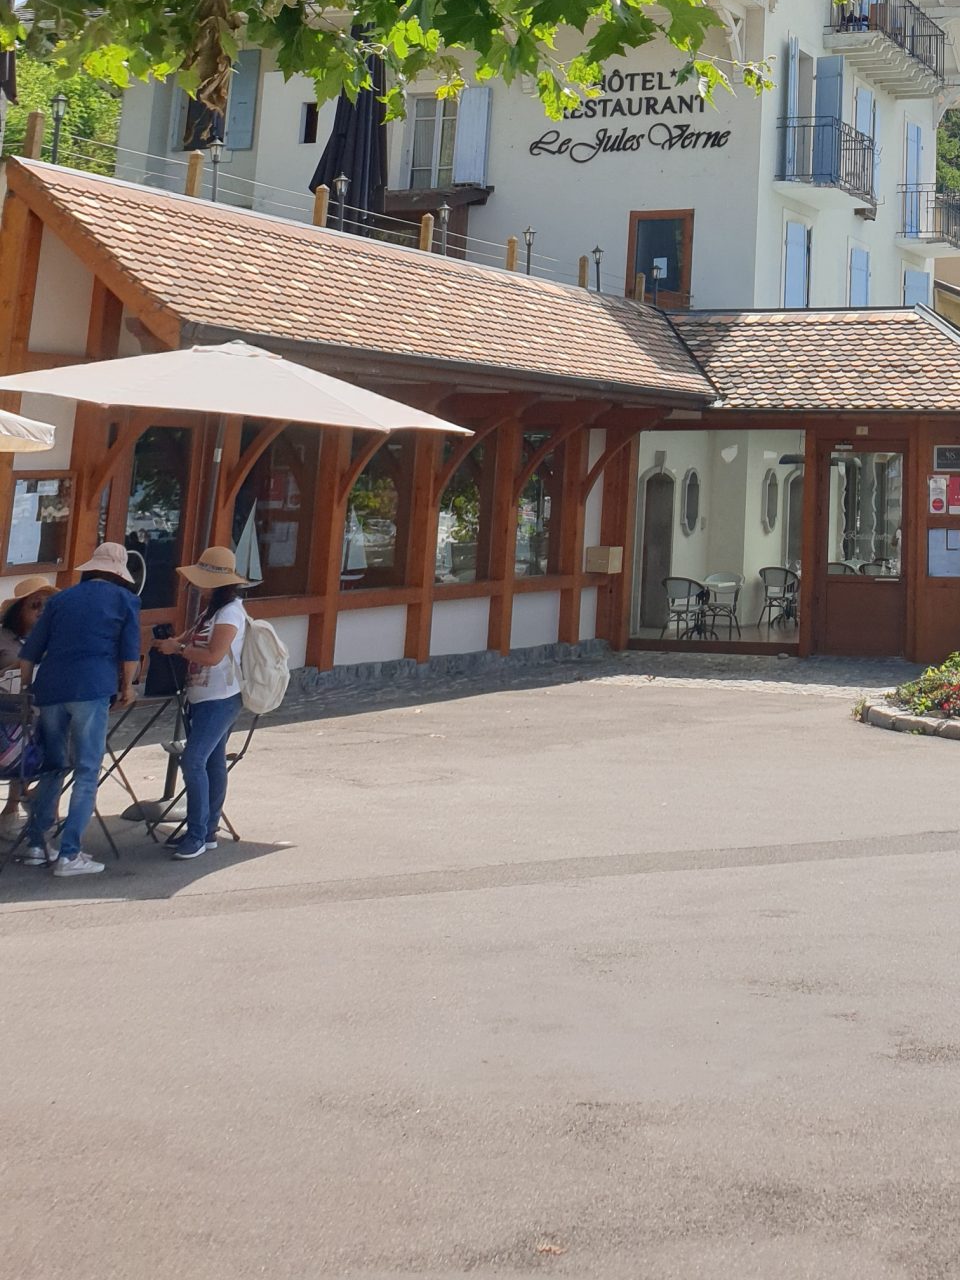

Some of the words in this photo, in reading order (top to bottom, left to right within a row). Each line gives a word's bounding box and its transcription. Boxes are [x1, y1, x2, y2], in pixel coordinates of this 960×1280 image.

[529, 130, 572, 156] Le
[569, 126, 645, 163] Jules
[647, 122, 731, 151] Verne
